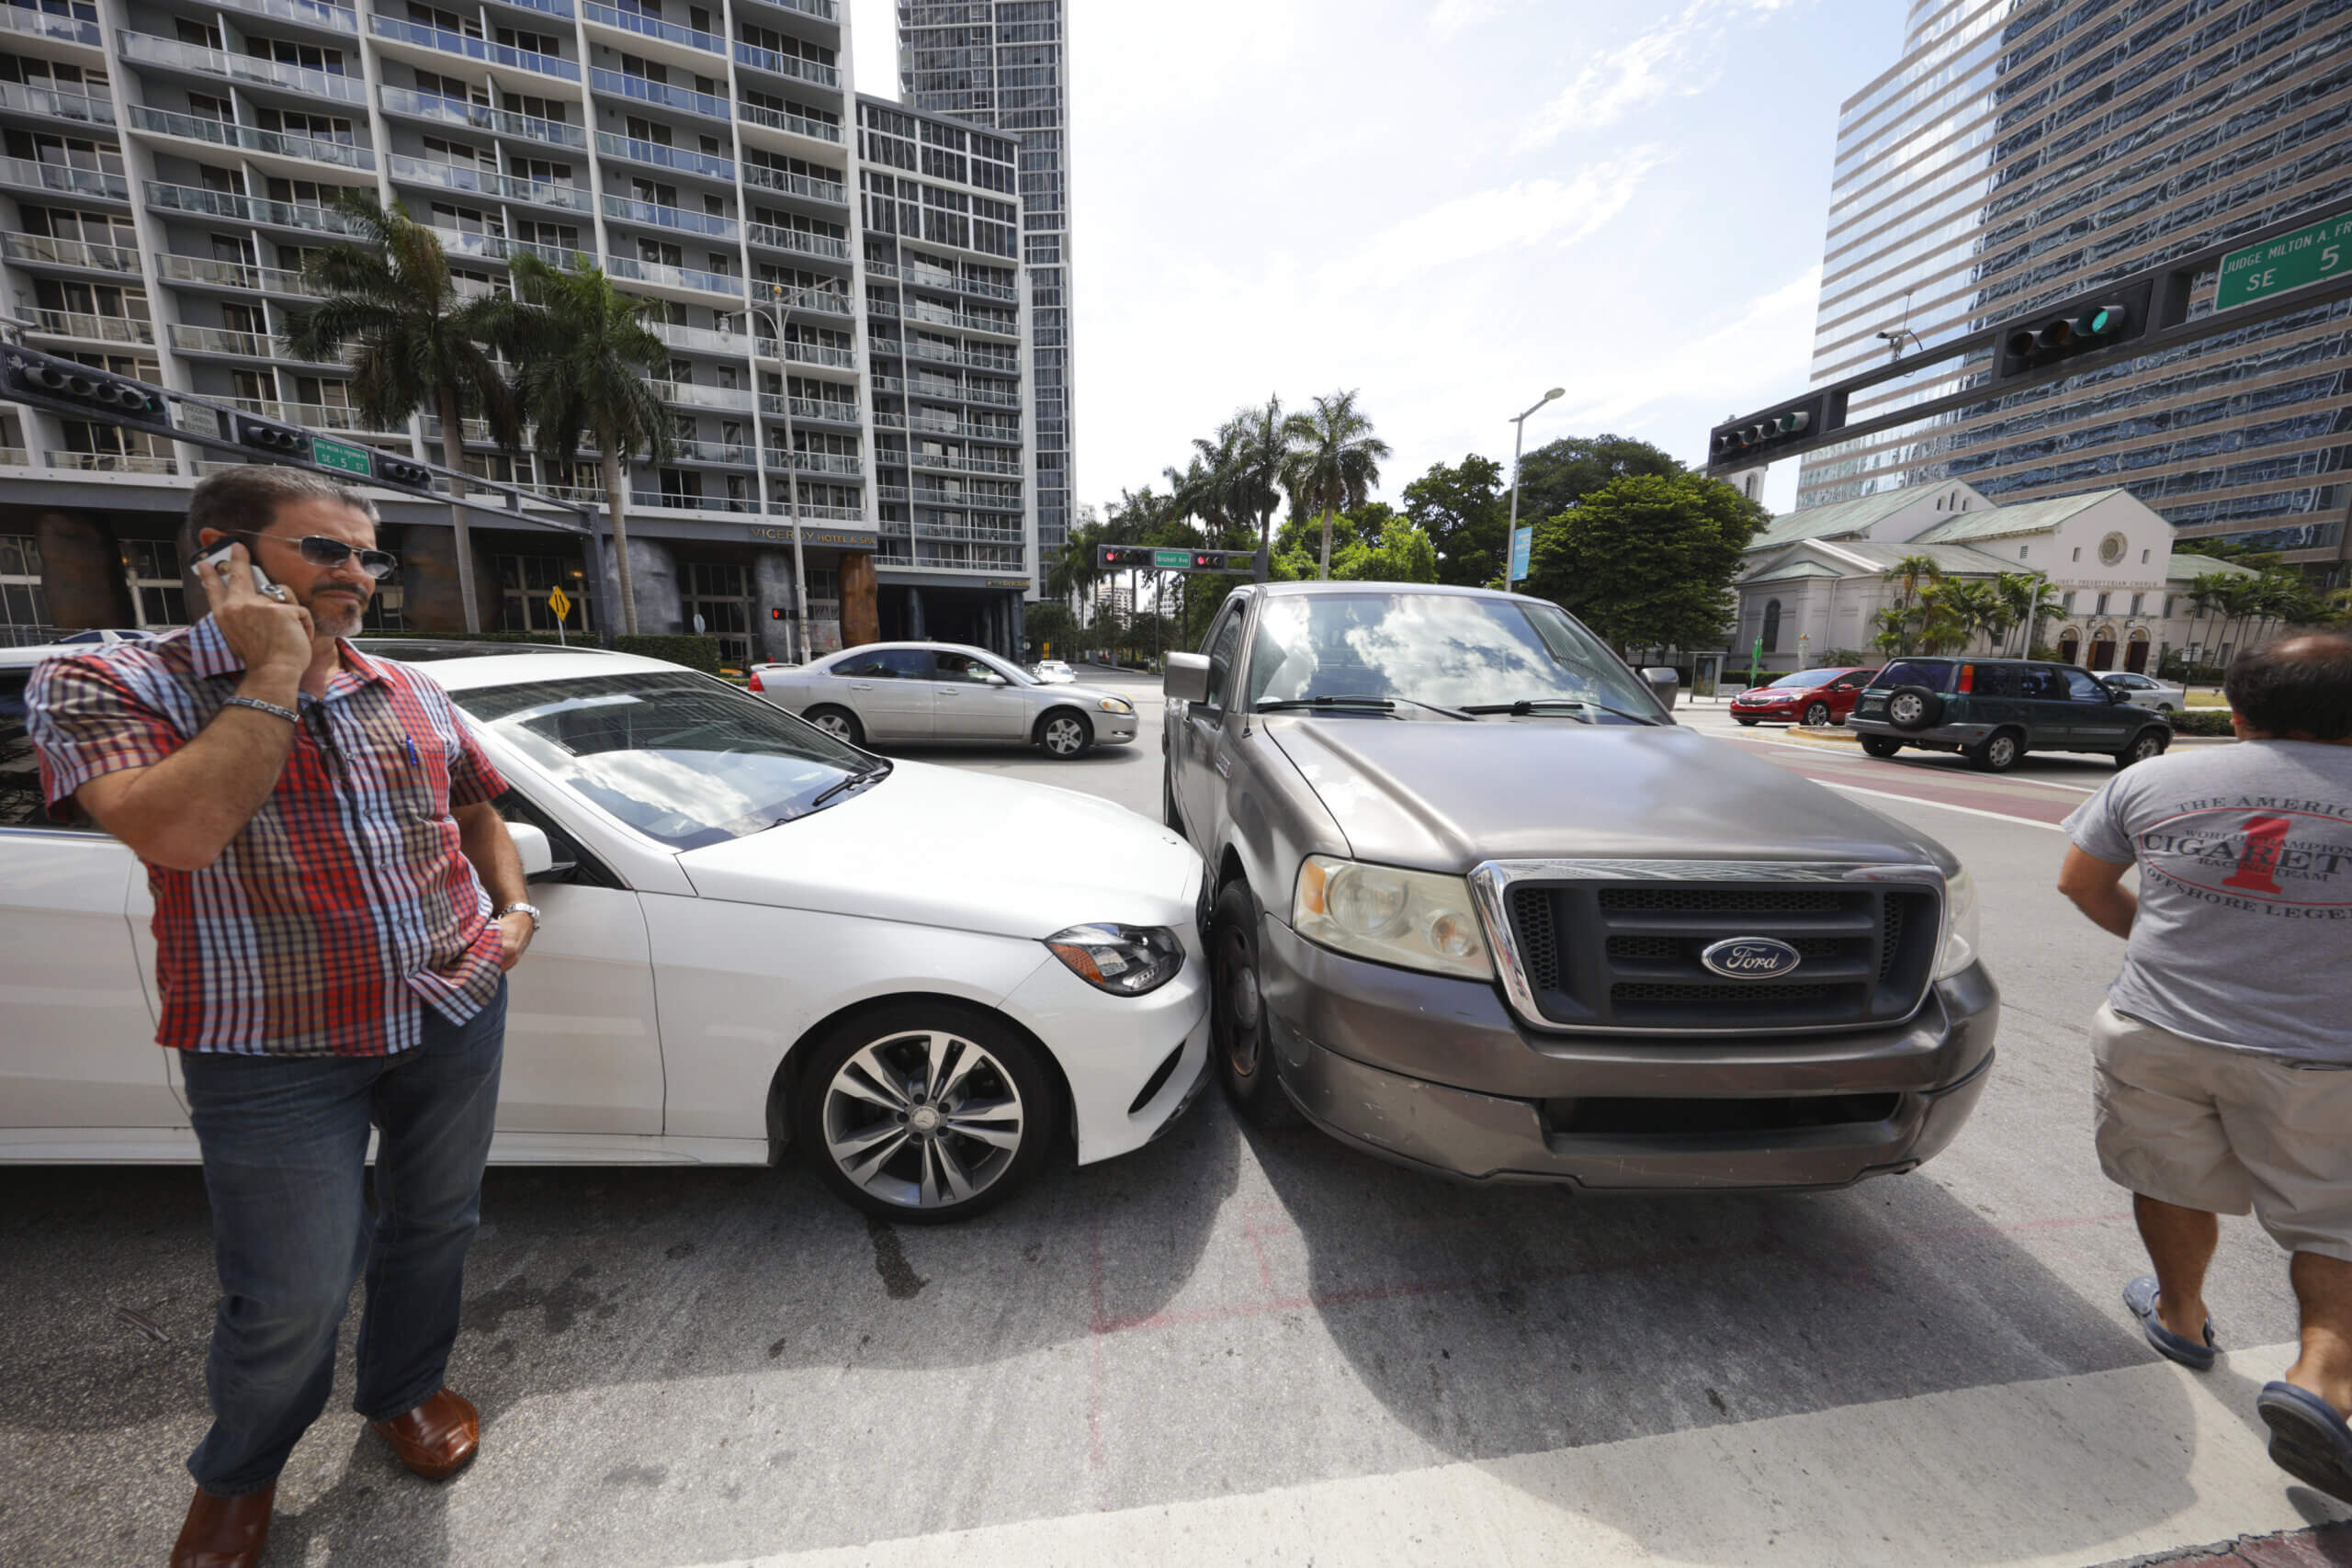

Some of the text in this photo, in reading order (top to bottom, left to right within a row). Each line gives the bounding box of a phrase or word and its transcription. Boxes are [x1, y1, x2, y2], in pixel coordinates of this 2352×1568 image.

[2223, 250, 2263, 274] JUDGE
[2267, 234, 2312, 260] MILTON
[2246, 244, 2340, 291] SE 5
[816, 535, 847, 545] HOTEL
[860, 536, 876, 545] SPA
[2176, 797, 2226, 812] THE
[2186, 829, 2245, 842] WORLD
[2272, 865, 2330, 882] TEAM
[2147, 868, 2352, 919] OFFSHORE LEGE
[1726, 945, 1780, 969] Ford
